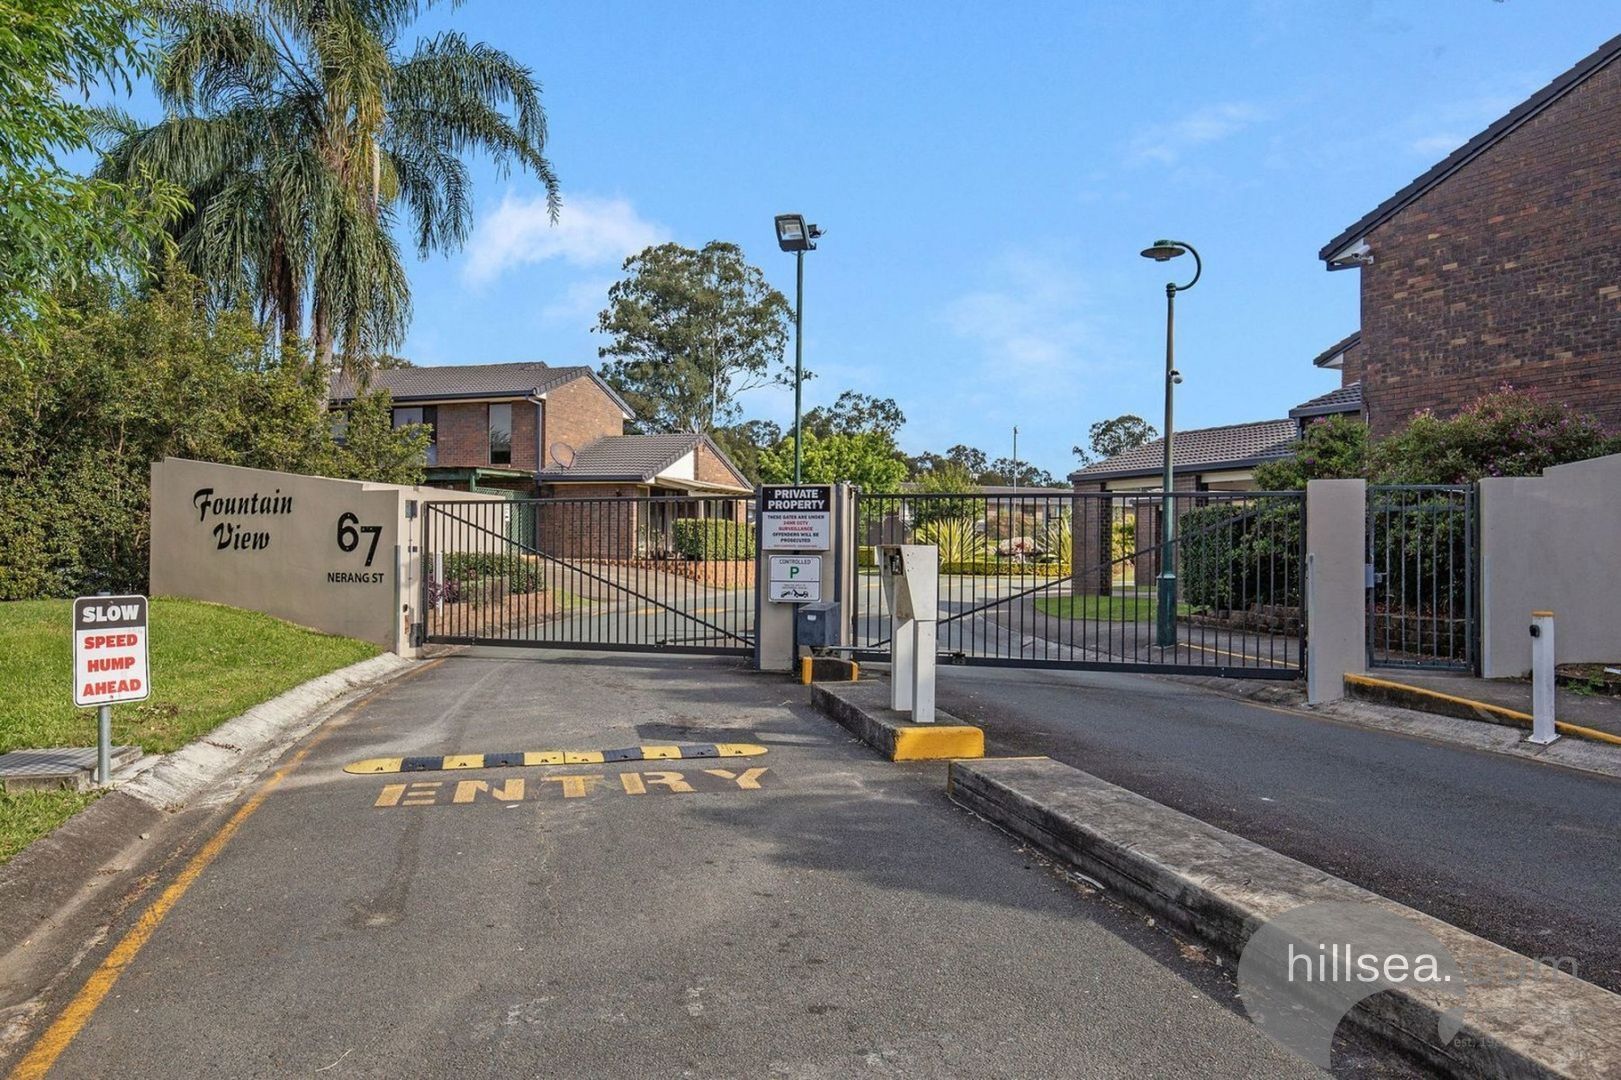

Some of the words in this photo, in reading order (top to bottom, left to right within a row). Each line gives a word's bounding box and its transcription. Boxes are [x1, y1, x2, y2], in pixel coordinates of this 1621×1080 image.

[774, 489, 819, 499] PRIVATE
[193, 487, 293, 522] Fountain
[768, 500, 825, 509] PROPERTY
[213, 522, 270, 550] View
[336, 511, 383, 567] 67
[327, 572, 370, 583] NERANG
[371, 572, 385, 583] ST
[790, 566, 800, 579] P
[82, 604, 140, 623] SLOW
[84, 633, 138, 650] SPEED
[87, 656, 136, 673] HUMP
[82, 678, 142, 697] AHEAD
[373, 767, 769, 807] ENTRY
